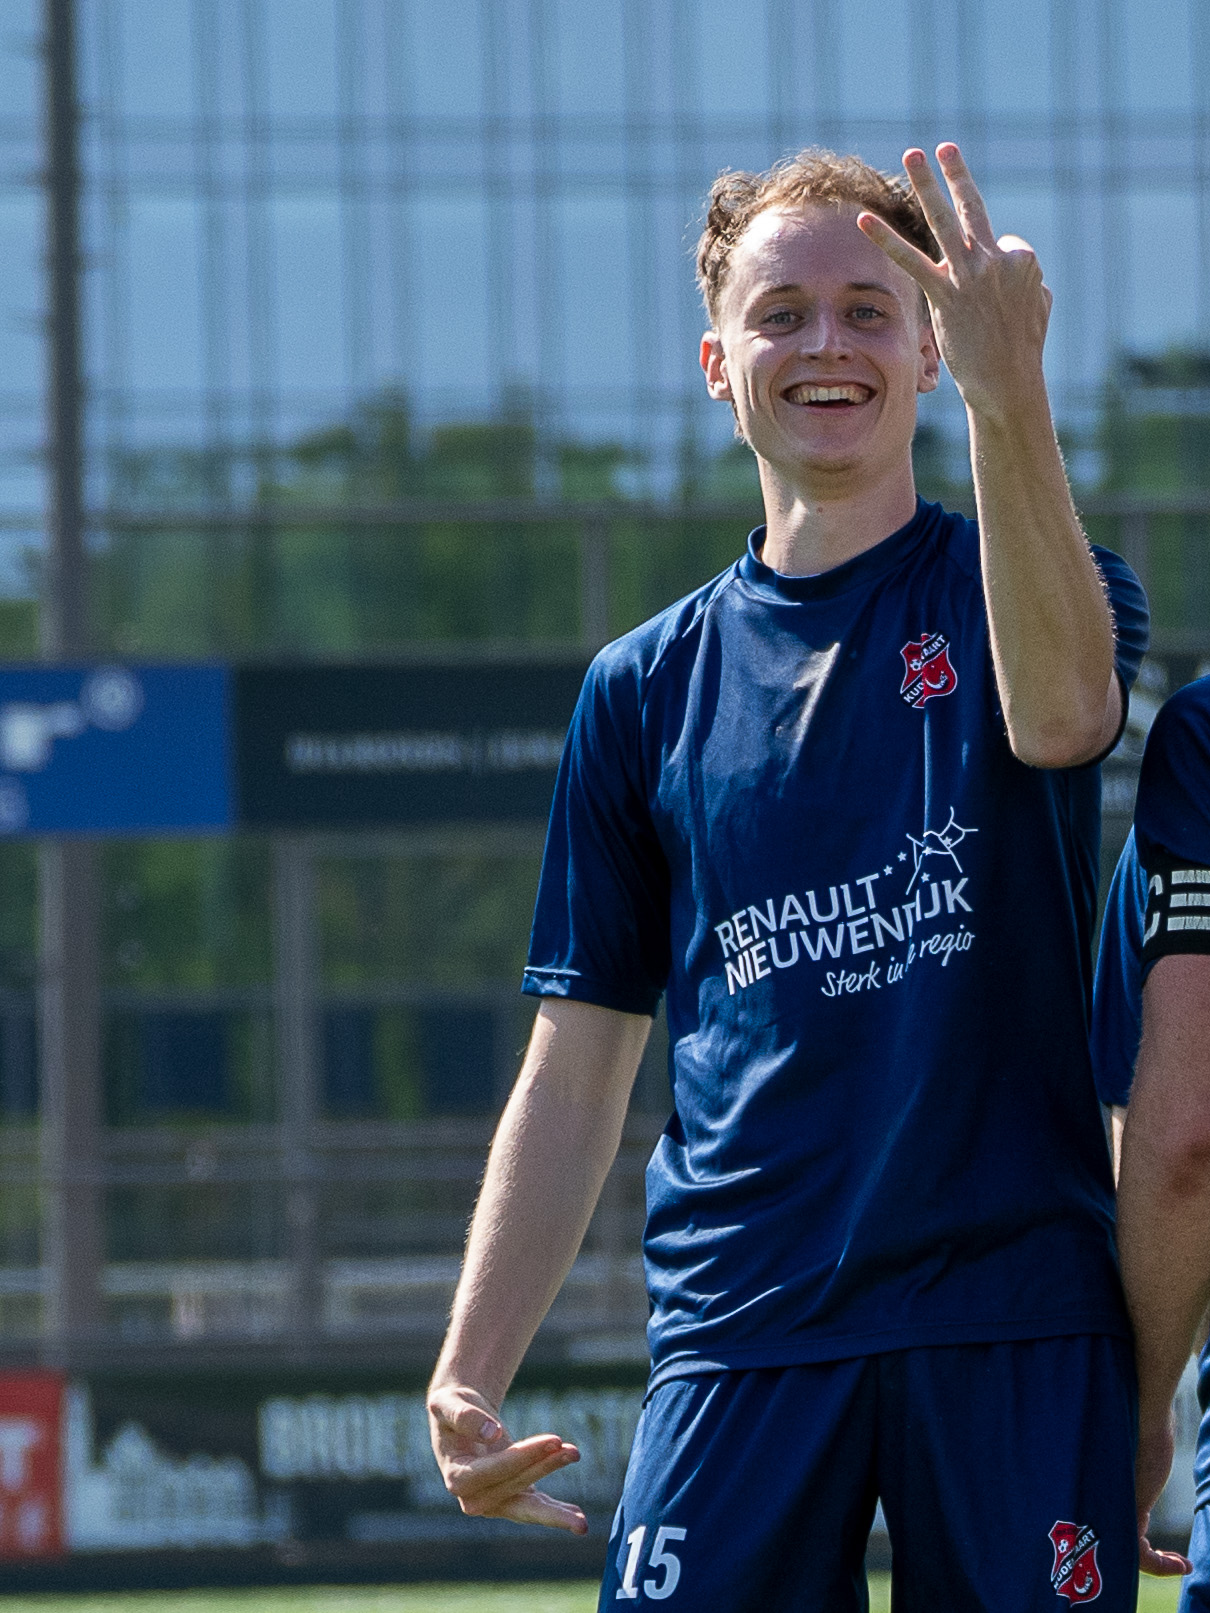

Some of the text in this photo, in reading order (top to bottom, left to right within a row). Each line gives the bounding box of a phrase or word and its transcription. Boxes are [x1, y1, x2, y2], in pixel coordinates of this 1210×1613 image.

[714, 873, 880, 958] RENAULT
[821, 959, 882, 998] Sterk
[919, 923, 976, 967] regio
[615, 1525, 688, 1600] 15
